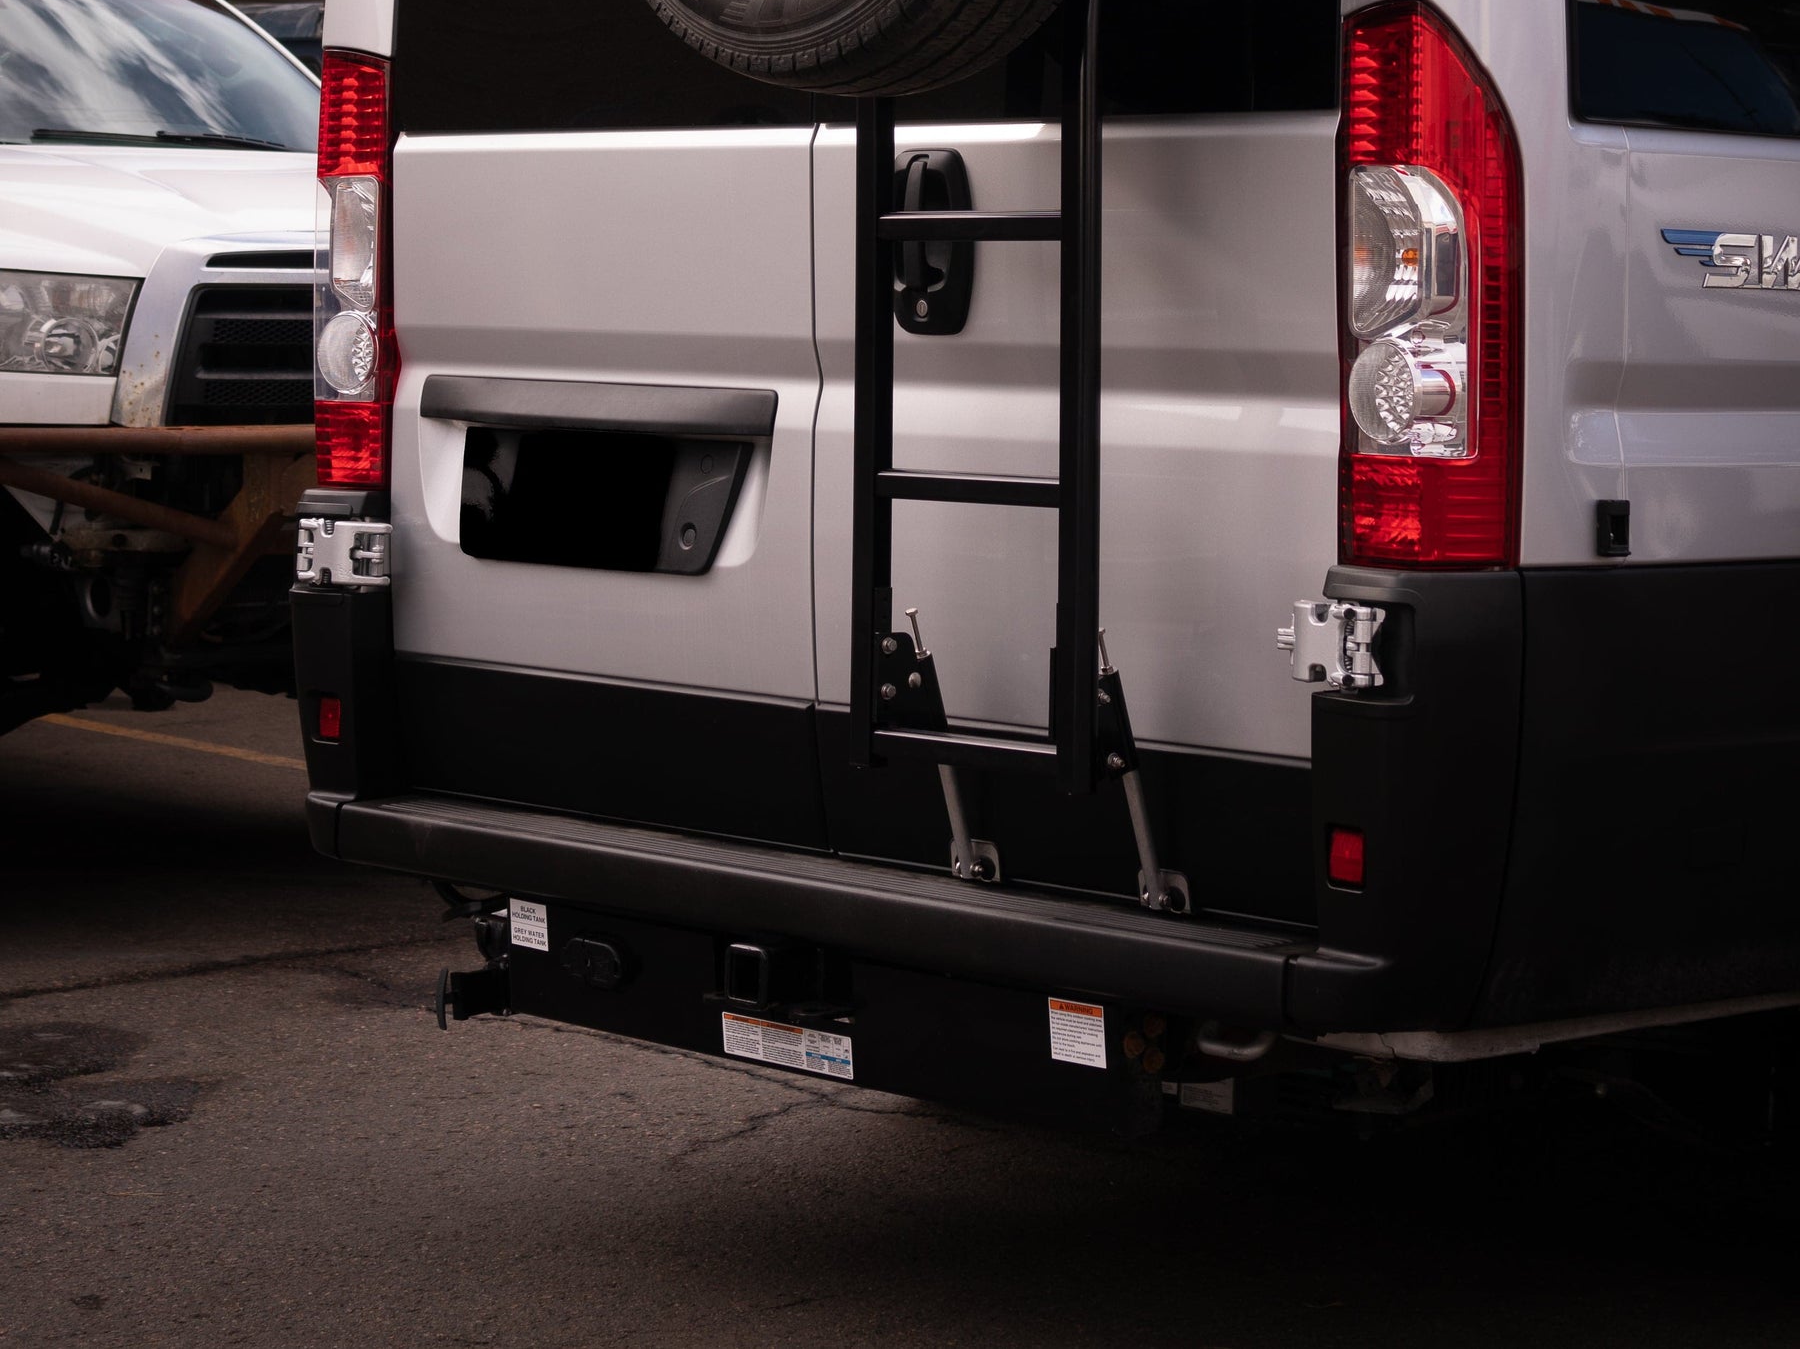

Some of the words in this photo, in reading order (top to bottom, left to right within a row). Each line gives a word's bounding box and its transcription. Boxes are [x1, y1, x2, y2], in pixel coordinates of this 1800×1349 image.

[520, 906, 536, 914] BLACK
[512, 911, 532, 921] HOLDING
[514, 927, 527, 935] GREY
[513, 934, 533, 944] HOLDING
[534, 939, 546, 947] TANK
[1065, 1002, 1094, 1014] WARNING
